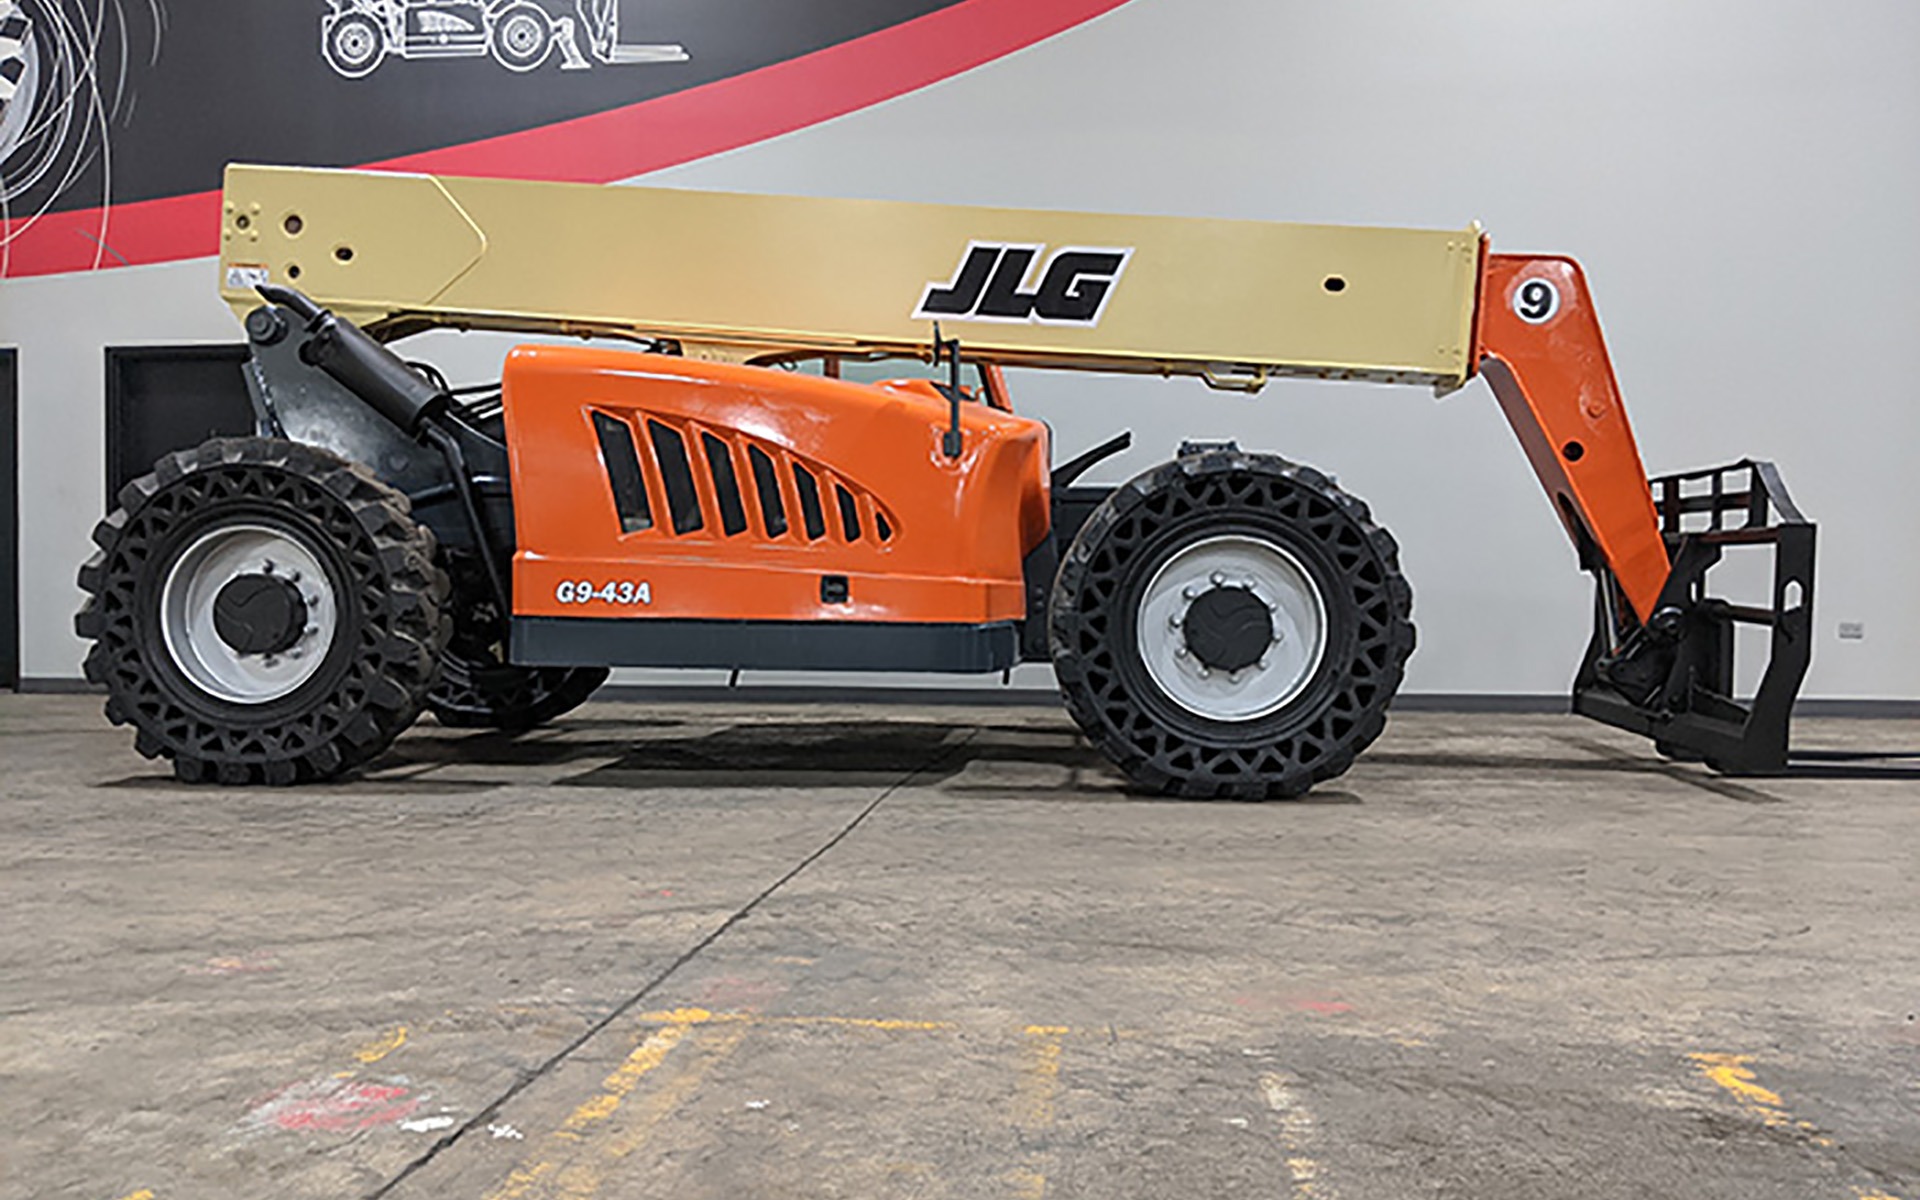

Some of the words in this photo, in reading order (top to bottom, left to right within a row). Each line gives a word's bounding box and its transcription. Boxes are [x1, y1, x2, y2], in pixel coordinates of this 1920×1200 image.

[919, 245, 1126, 321] JLG
[1520, 281, 1553, 319] 9
[556, 580, 652, 604] G9-43A
